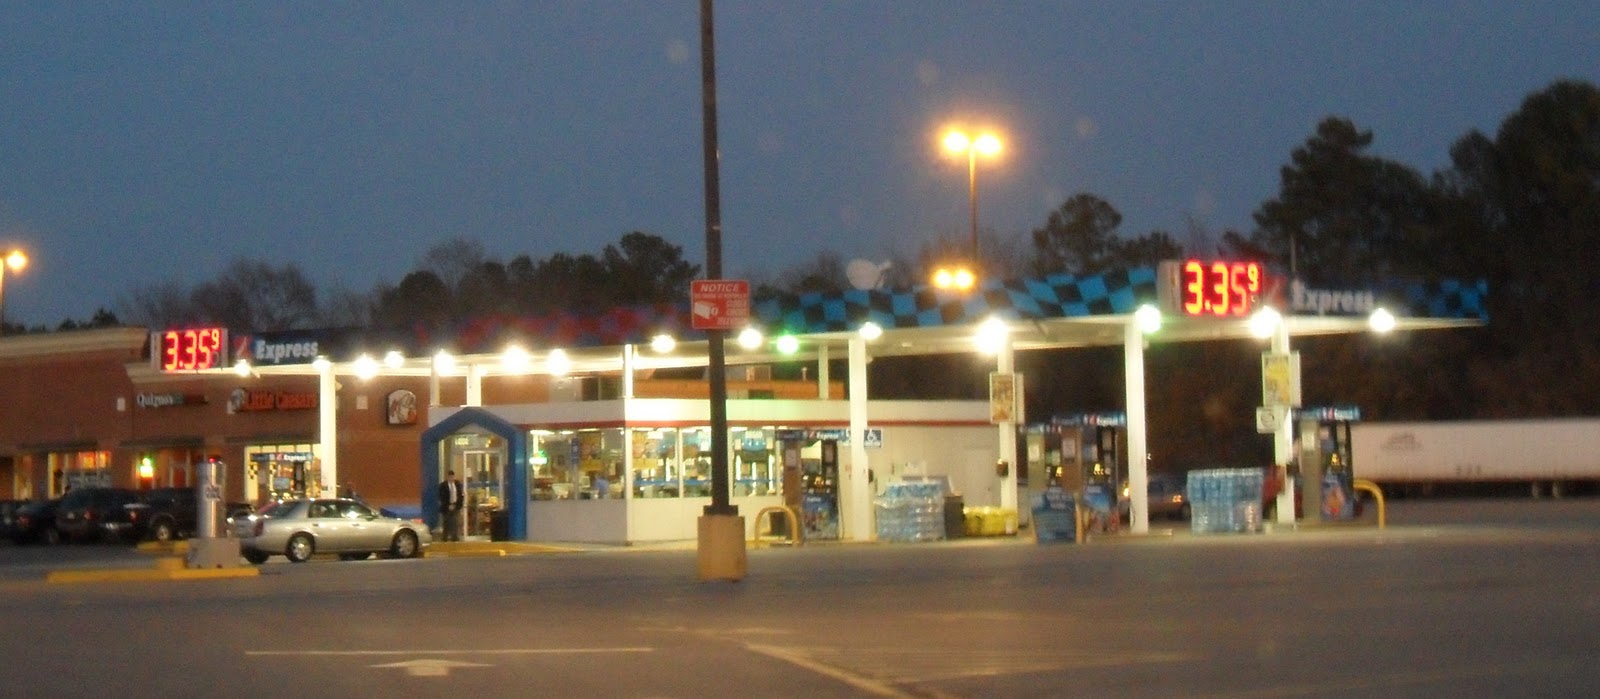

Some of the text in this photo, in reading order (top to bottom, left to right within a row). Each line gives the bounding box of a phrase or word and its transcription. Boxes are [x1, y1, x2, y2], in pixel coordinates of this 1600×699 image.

[700, 283, 740, 292] NOTICE
[1290, 279, 1374, 315] Express
[255, 339, 319, 363] Express
